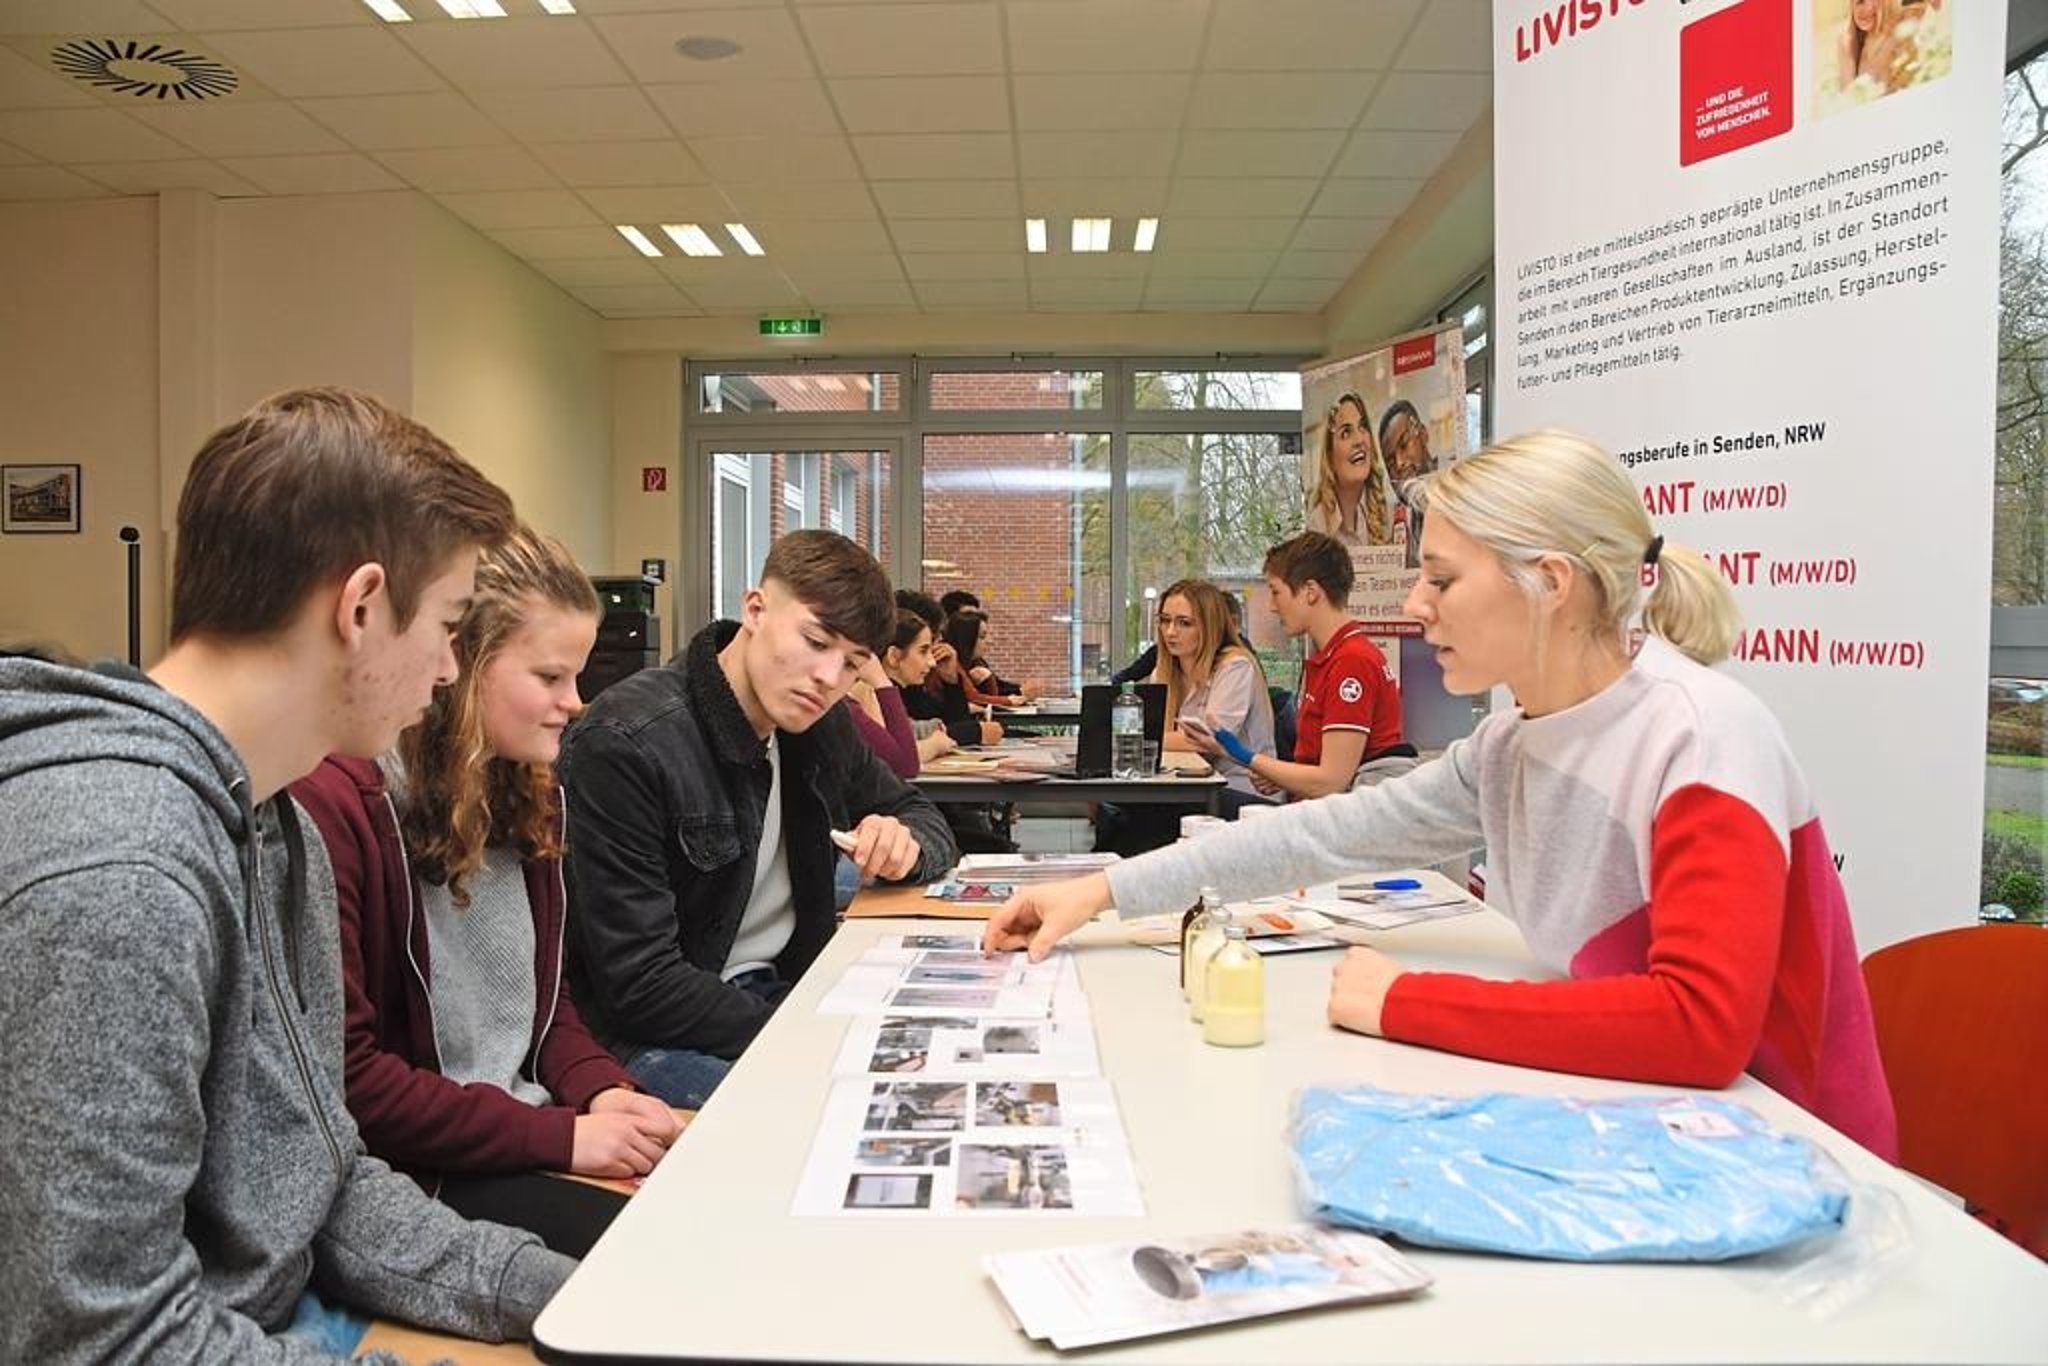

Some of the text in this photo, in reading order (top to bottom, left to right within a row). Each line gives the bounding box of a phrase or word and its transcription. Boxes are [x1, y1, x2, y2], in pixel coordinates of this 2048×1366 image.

[1517, 0, 1645, 62] LIVIS
[1696, 91, 1769, 127] ZUFRIEDENHEIT
[1705, 93, 1726, 108] UND
[1696, 127, 1715, 139] VON
[1559, 253, 1573, 268] ist
[1576, 245, 1600, 263] eine
[1603, 215, 1695, 254] mittelständisch
[1699, 196, 1763, 228] geprägte
[1769, 140, 1949, 206] Unternehmensgruppe,
[1518, 170, 1949, 302] die im Bereich Tiergesundheit international tätig ist. In Zusammen-
[1518, 196, 1949, 325] arbeit mit unseren Gesellschaften im Ausland, ist der Standort
[1518, 227, 1949, 346] Senden in den Bereichen Produktentwicklung, Zulassung, Herstel-
[1544, 338, 1599, 360] Marketing
[1602, 332, 1624, 350] und
[1627, 320, 1675, 344] Vertrieb
[1679, 316, 1702, 331] von
[1706, 285, 1834, 326] Tierarzneimitteln,
[1839, 261, 1948, 297] Ergänzungs-
[1551, 367, 1572, 383] und
[1574, 351, 1650, 379] Pflegemitteln
[1653, 345, 1683, 362] tätig.
[1618, 422, 1827, 469] ngsberufe in Senden, NRW
[1643, 481, 1787, 516] ANT (M/W/D)
[1769, 558, 1857, 586] (M/W/D)
[1731, 628, 1926, 670] MANN (M/W/D)
